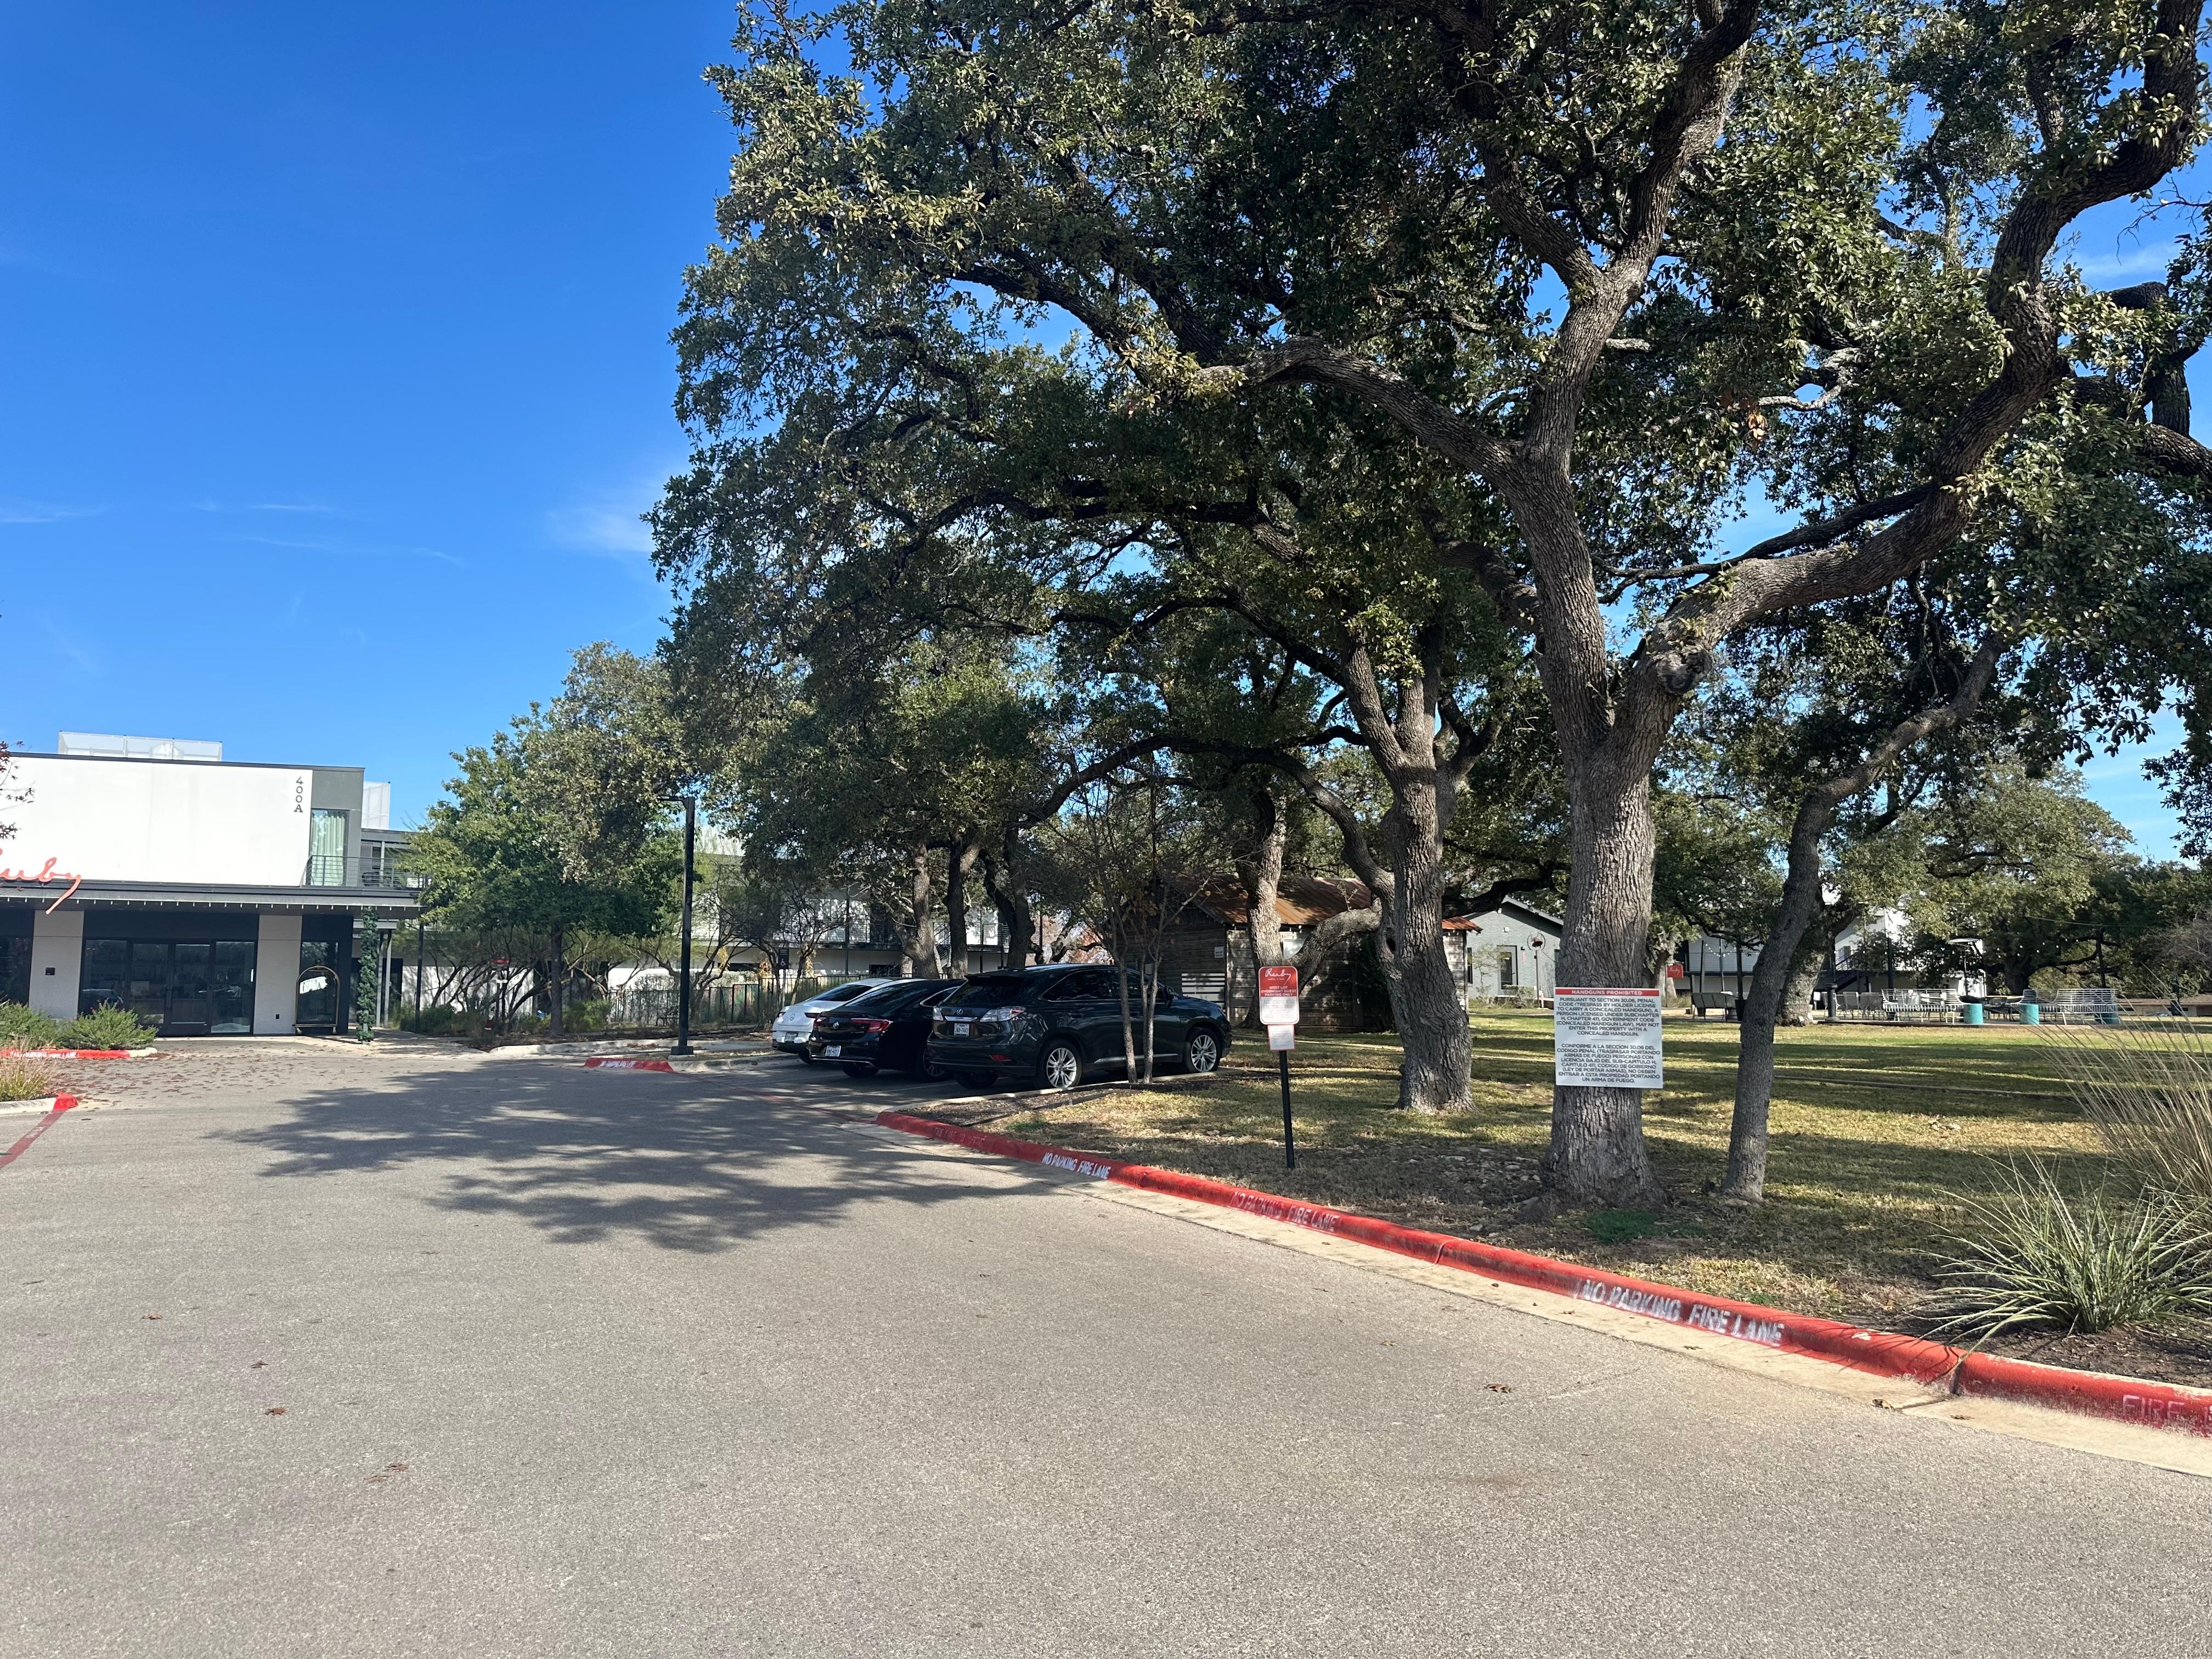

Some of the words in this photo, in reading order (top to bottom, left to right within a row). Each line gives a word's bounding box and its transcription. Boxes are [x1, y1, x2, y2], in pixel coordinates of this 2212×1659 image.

[294, 777, 303, 812] 400A
[0, 848, 81, 915] uby
[1265, 968, 1291, 985] Ruby
[1041, 1152, 1052, 1165] NO
[1051, 1154, 1078, 1171] PARKING
[1076, 1160, 1094, 1175] FIRE
[1091, 1163, 1111, 1180] LANE
[1230, 1191, 1246, 1207] NO
[1244, 1195, 1284, 1219] PARKING
[1286, 1205, 1312, 1223] FIRE
[1311, 1211, 1340, 1232] LANE
[1583, 1279, 1606, 1302] NO
[1606, 1286, 1681, 1322] PARKING
[1688, 1304, 1731, 1334] FIRE
[1731, 1314, 1785, 1347] LANE
[2123, 1395, 2185, 1426] FIRE
